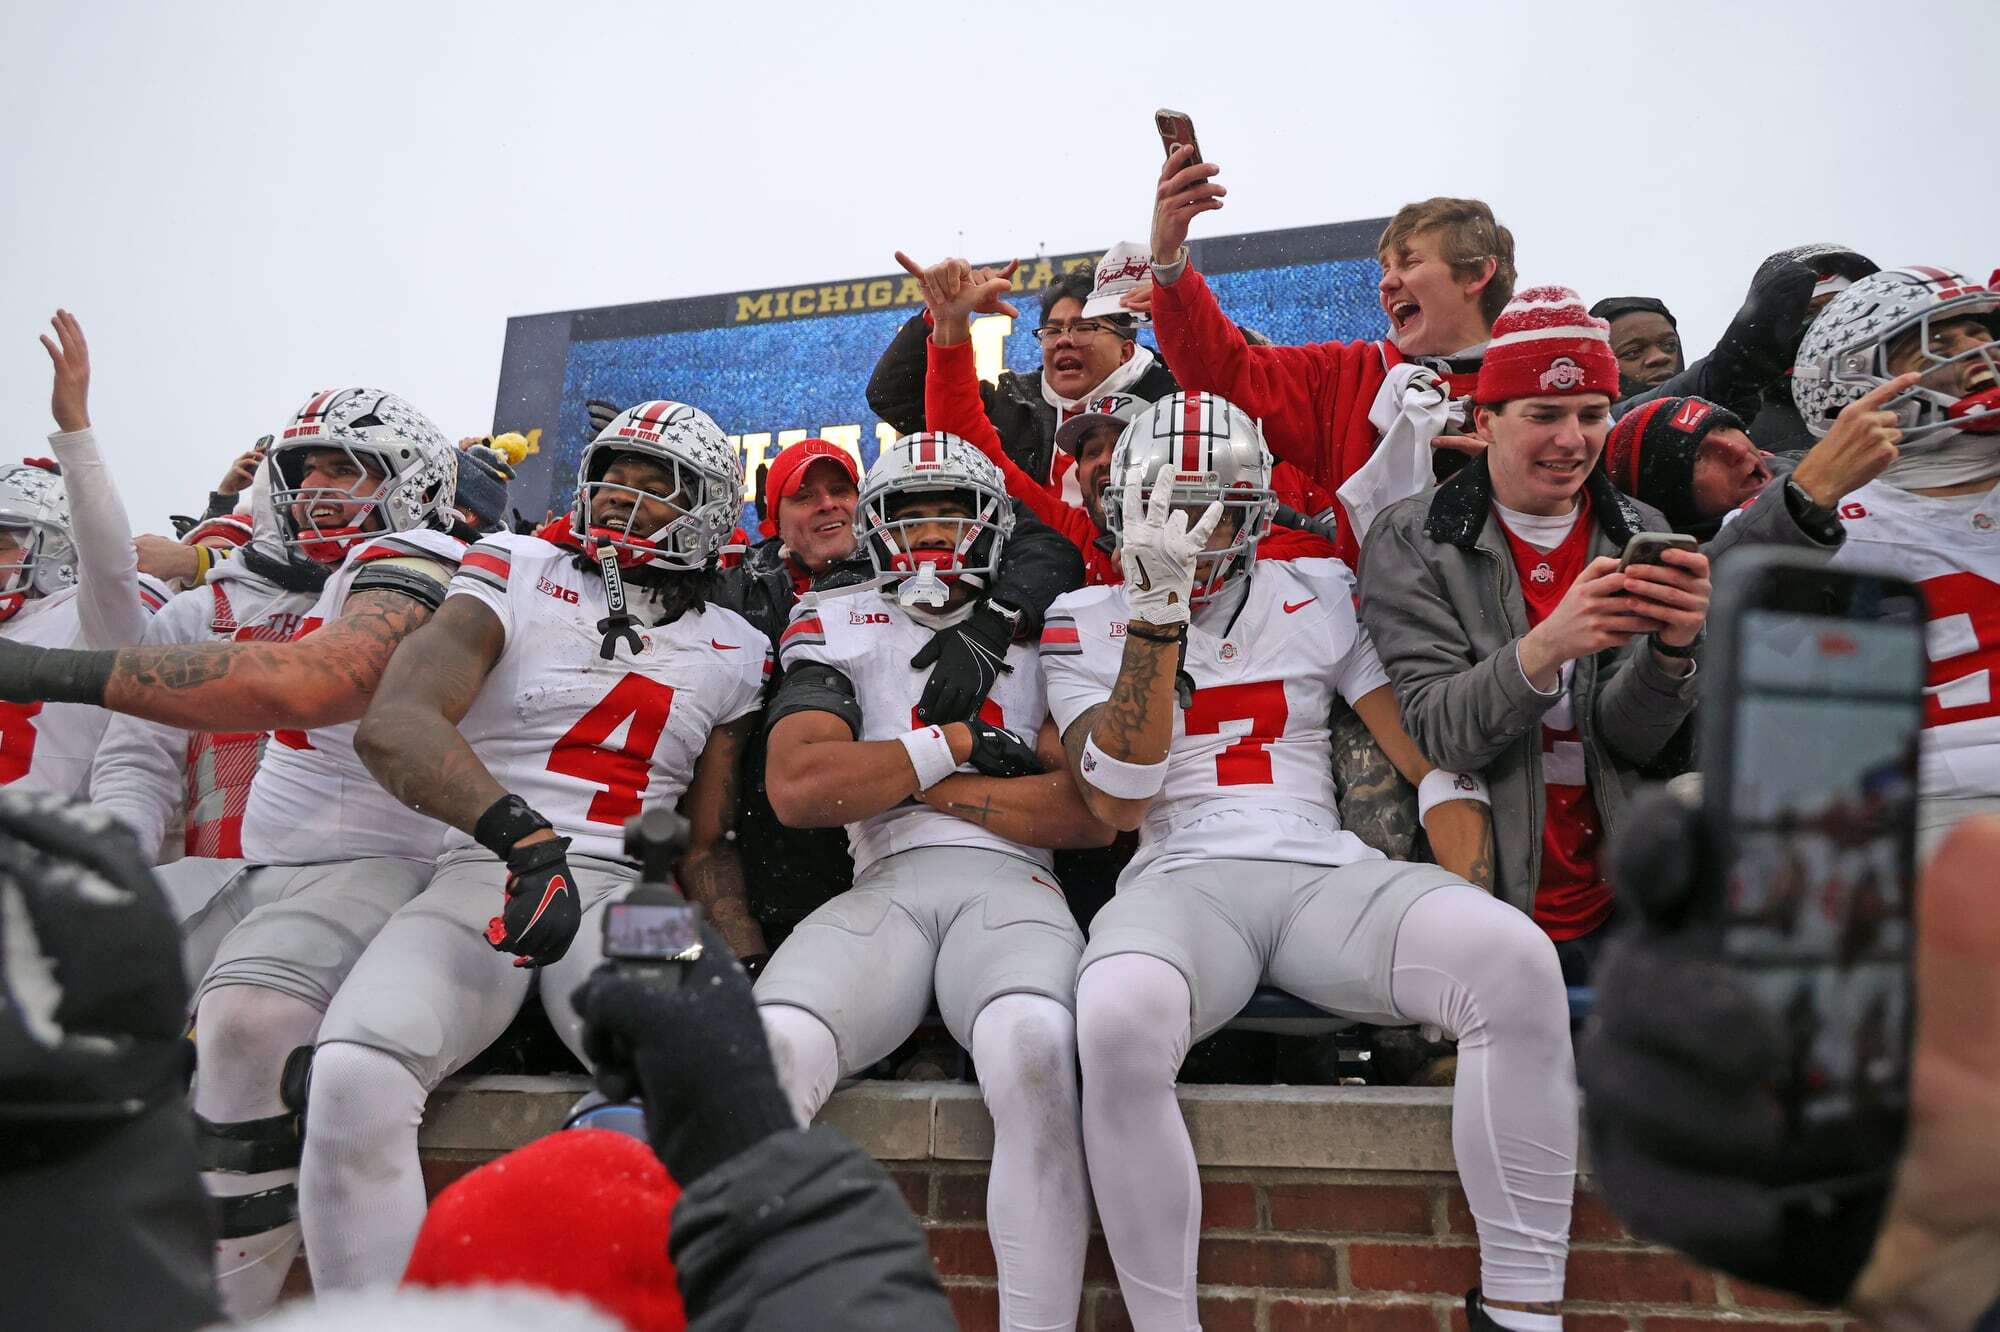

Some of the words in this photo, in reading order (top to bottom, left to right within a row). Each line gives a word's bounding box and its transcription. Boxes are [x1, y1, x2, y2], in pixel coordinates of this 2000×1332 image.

[735, 277, 926, 322] MICHIGA
[604, 558, 621, 608] BATTLE
[546, 671, 675, 826] 4
[1184, 679, 1289, 787] 7
